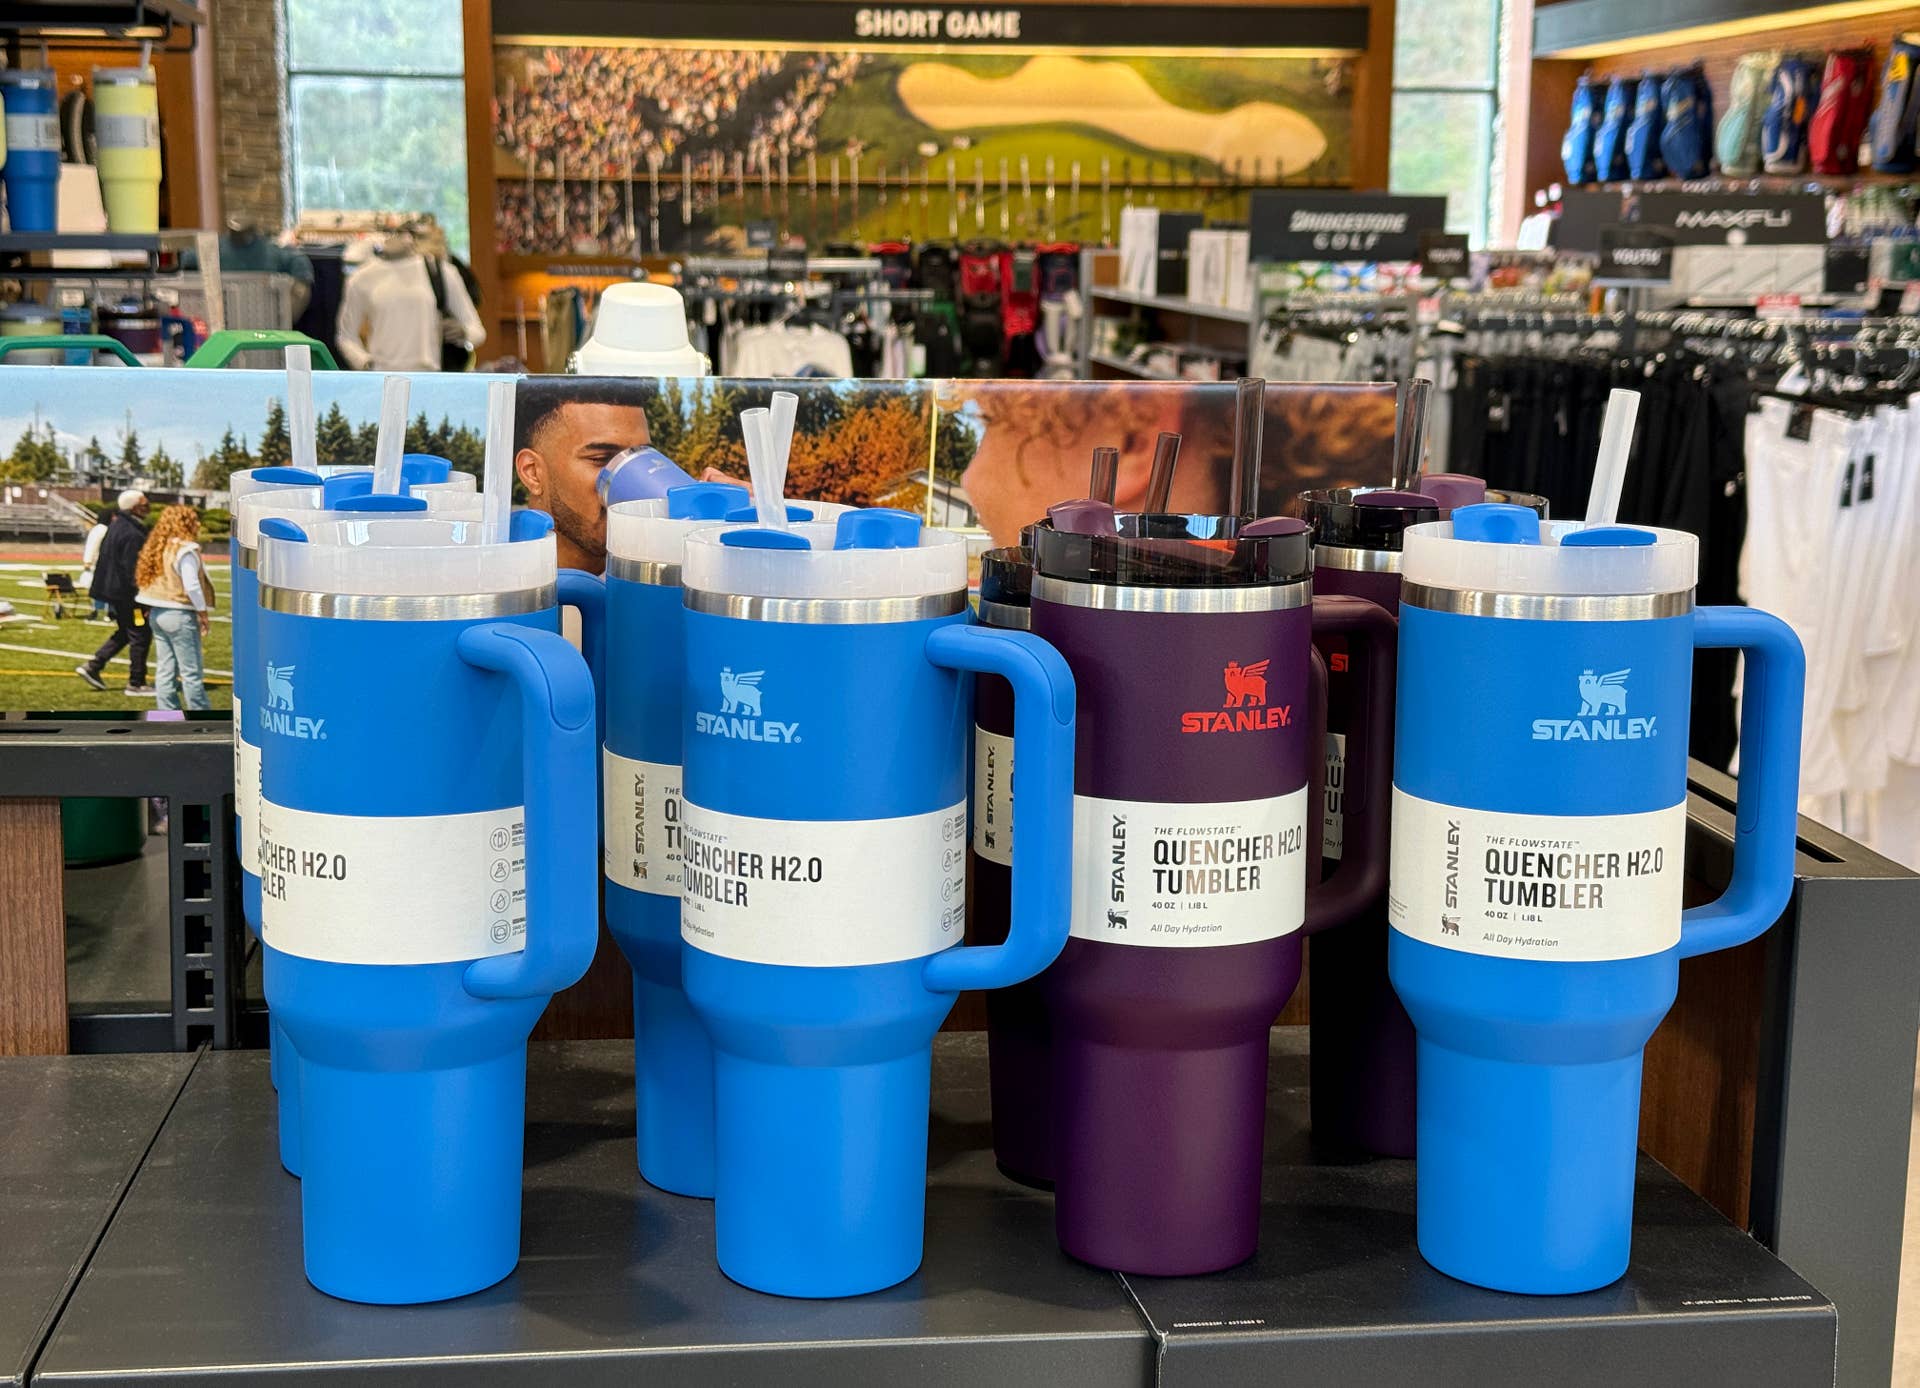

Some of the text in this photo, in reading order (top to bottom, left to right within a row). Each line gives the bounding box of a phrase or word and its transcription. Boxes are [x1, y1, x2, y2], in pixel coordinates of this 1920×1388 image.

[856, 9, 1021, 39] SHORT GAME
[1675, 209, 1792, 229] MAXFLI
[1313, 232, 1379, 251] GOLF
[1154, 827, 1174, 835] THE
[1486, 835, 1505, 845] THE
[1153, 825, 1302, 866] QUENCHER H2.0
[302, 850, 347, 881] H2.0
[684, 835, 763, 880] QUENCHER
[771, 856, 822, 883] H2.0
[1485, 847, 1663, 880] QUENCHER H2.0
[684, 862, 748, 908] TUMBLER
[1152, 866, 1261, 895] TUMBLER
[1151, 901, 1162, 909] 40
[1164, 901, 1176, 909] OZ
[1484, 877, 1603, 909] TUMBLER
[1484, 910, 1495, 918] 40
[1497, 911, 1509, 920] OZ
[1150, 923, 1223, 934] All Day Hydration
[1482, 932, 1558, 947] All Day Hydration
